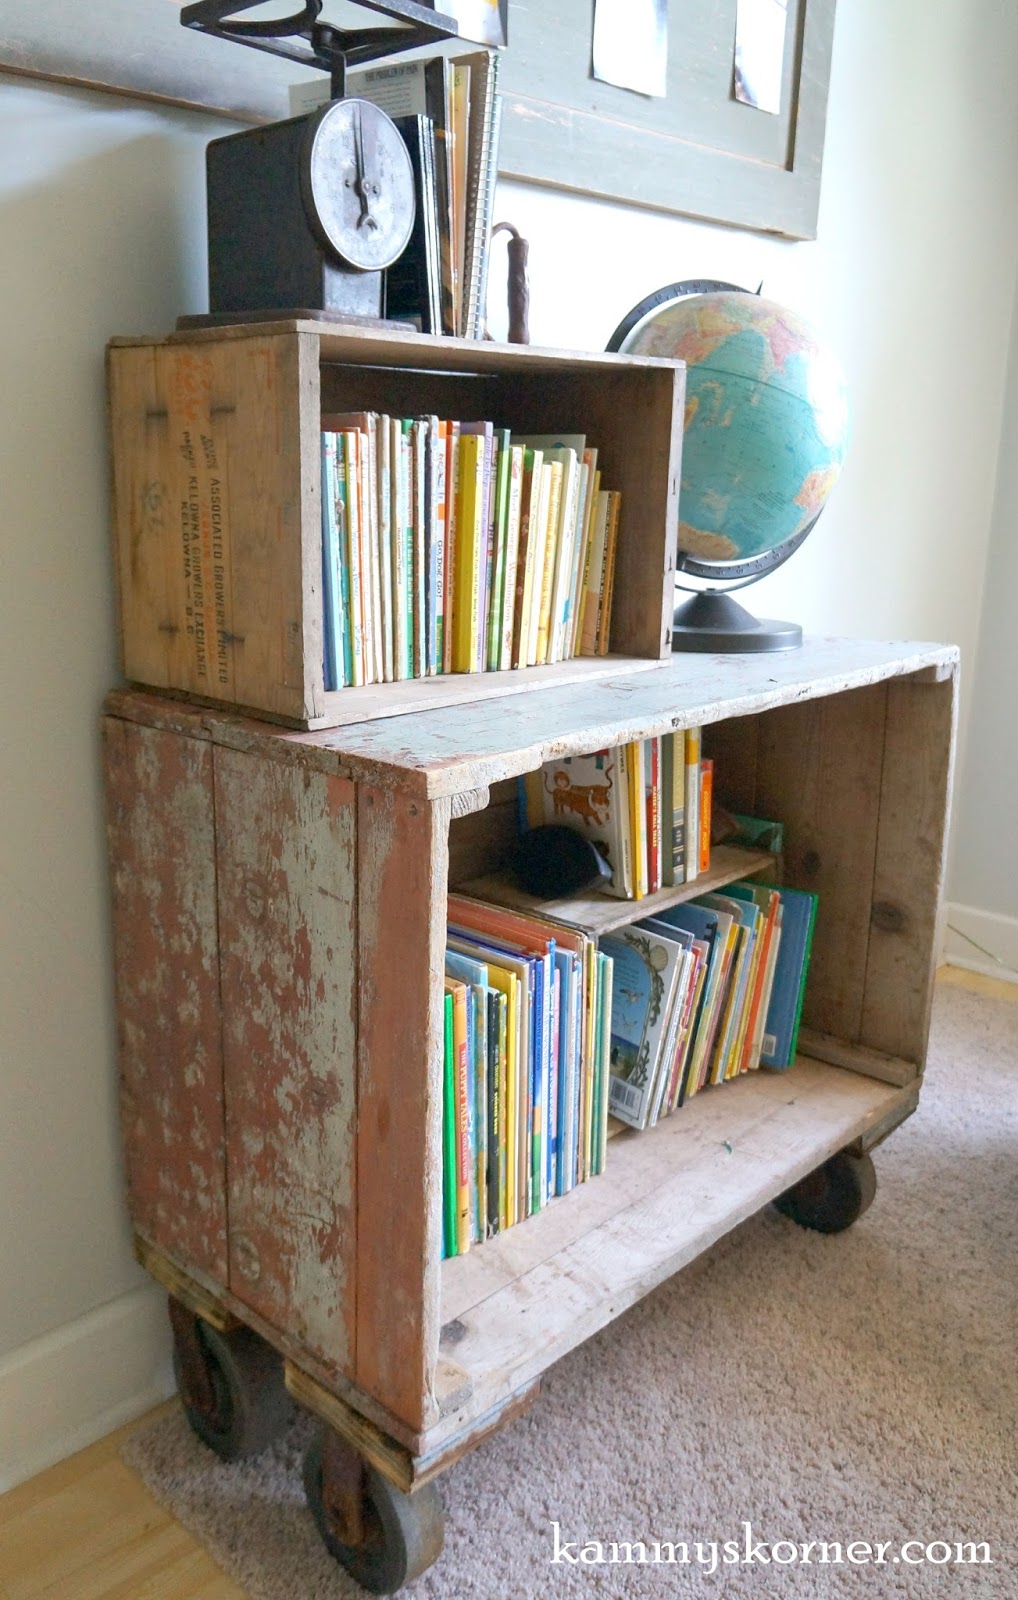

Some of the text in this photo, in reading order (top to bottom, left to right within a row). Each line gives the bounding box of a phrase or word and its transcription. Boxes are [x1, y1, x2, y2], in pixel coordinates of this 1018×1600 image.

[181, 501, 192, 579] KELOWNA
[508, 518, 518, 557] George
[189, 476, 207, 680] KELOWNA GROWERS EXCHANGE
[210, 477, 229, 685] ASSOCIATED GROWERS LIMITED
[505, 562, 516, 622] Washington
[459, 1066, 468, 1101] PUPPY
[460, 1102, 468, 1133] TALES
[461, 1133, 469, 1181] COLLECTION
